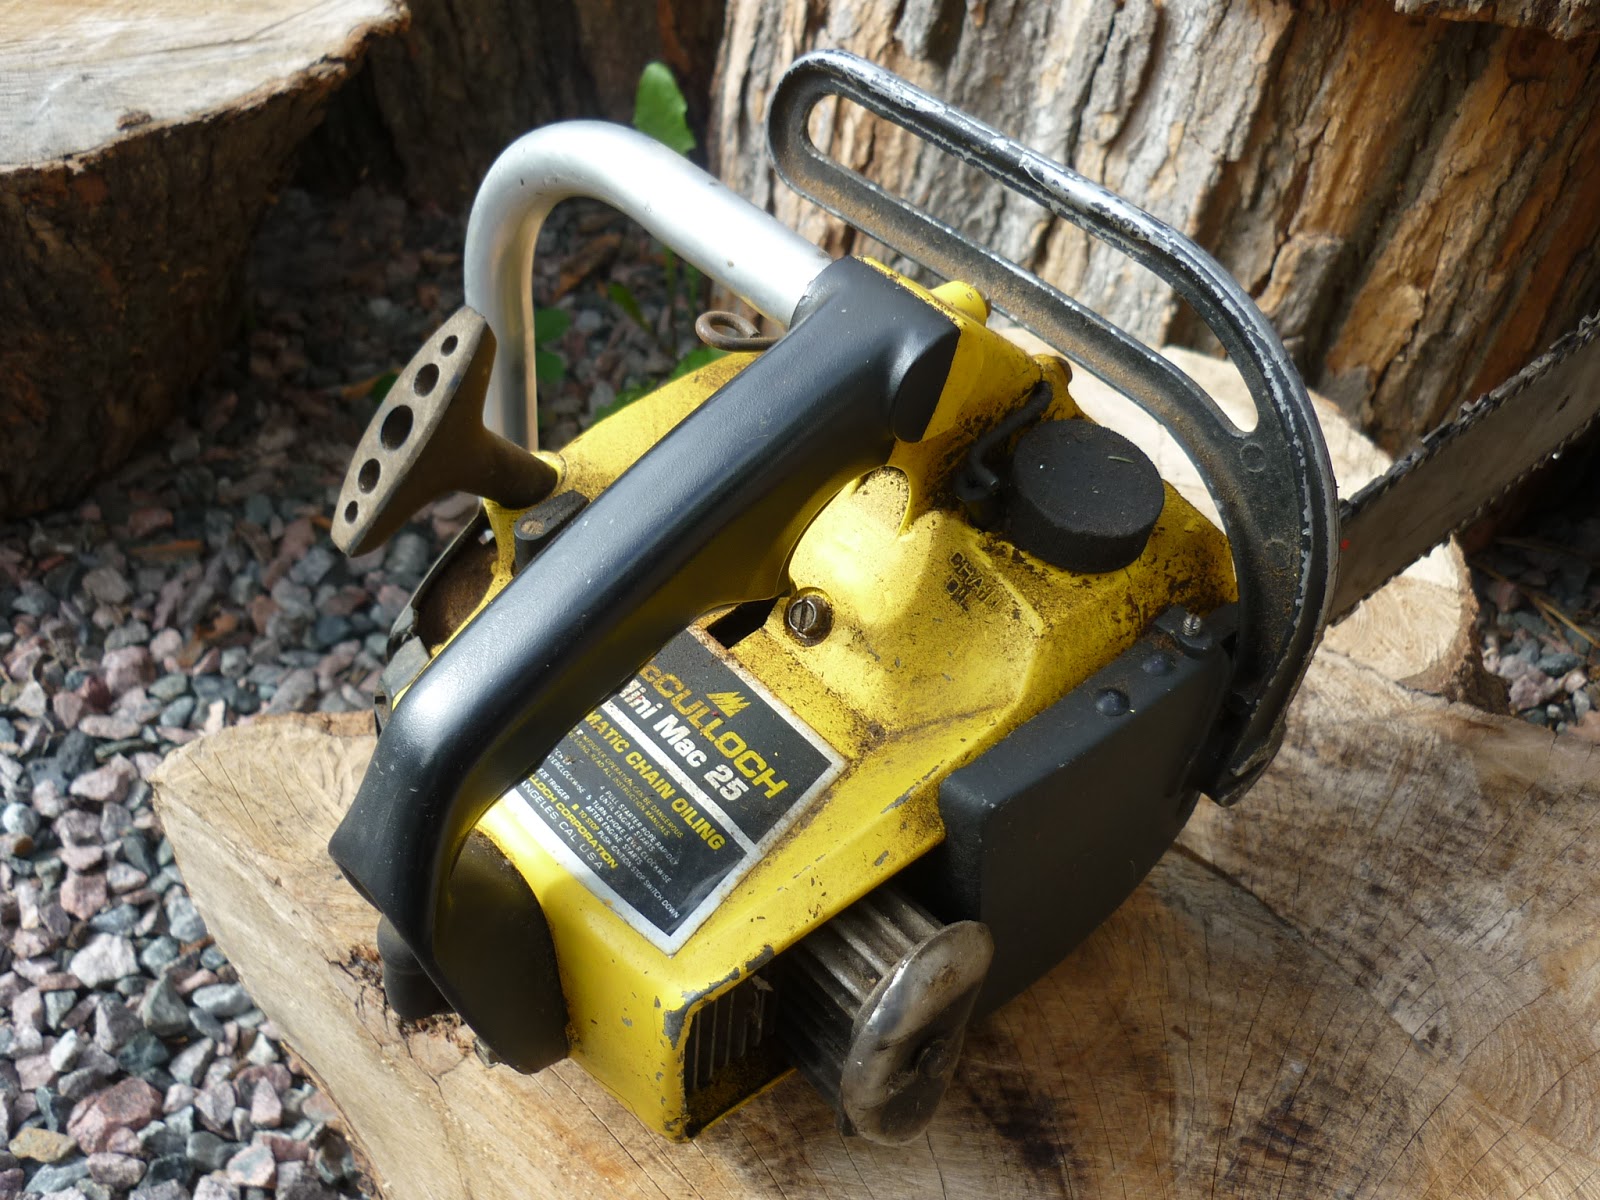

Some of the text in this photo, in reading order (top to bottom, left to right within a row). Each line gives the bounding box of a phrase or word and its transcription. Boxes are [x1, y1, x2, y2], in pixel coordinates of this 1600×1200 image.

[638, 657, 788, 799] cCULLOCH
[652, 713, 708, 768] Mac
[703, 764, 749, 801] 25
[547, 777, 570, 800] TRIGGER
[602, 768, 612, 777] ALL
[625, 750, 675, 800] CHAIN
[671, 797, 725, 850] OILING
[642, 796, 652, 805] BE
[555, 802, 618, 868] CORPORATION
[585, 805, 603, 822] AFTER
[600, 821, 623, 843] ENGINE
[592, 799, 607, 816] TURN
[605, 814, 625, 835] CHOKE
[623, 833, 642, 851] LEVER
[640, 851, 672, 884] CLOCKWISE
[598, 794, 615, 811] UNTIL
[613, 810, 635, 831] ENGINE
[604, 790, 618, 805] PULL
[617, 803, 642, 827] STARTER
[640, 826, 657, 842] ROPE
[578, 809, 587, 819] TO
[584, 817, 599, 831] STOP
[596, 830, 612, 845] PUSH
[630, 866, 645, 880] STOP
[642, 880, 663, 900] SWITCH
[660, 899, 680, 918] DOWN
